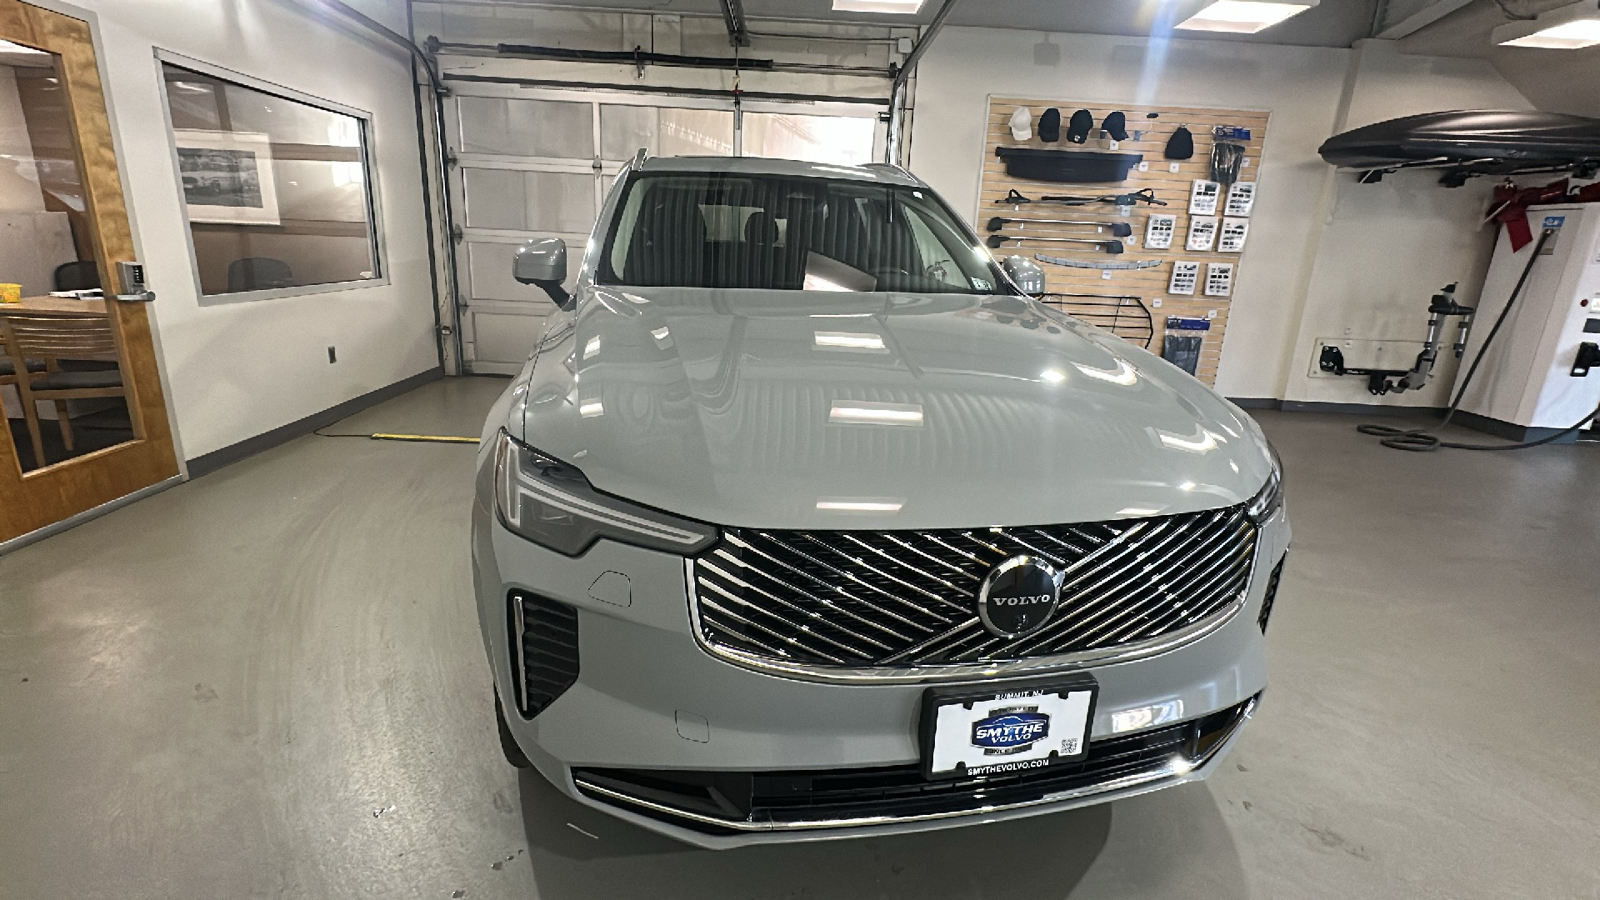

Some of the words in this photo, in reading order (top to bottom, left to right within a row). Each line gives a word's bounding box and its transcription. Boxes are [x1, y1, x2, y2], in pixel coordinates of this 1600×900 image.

[992, 594, 1051, 606] VOLVO
[1031, 689, 1044, 697] NJ
[976, 723, 1044, 739] SMYTHE
[991, 733, 1032, 744] VOLVO
[967, 759, 1050, 776] SMYTHEVOLVO.COM
